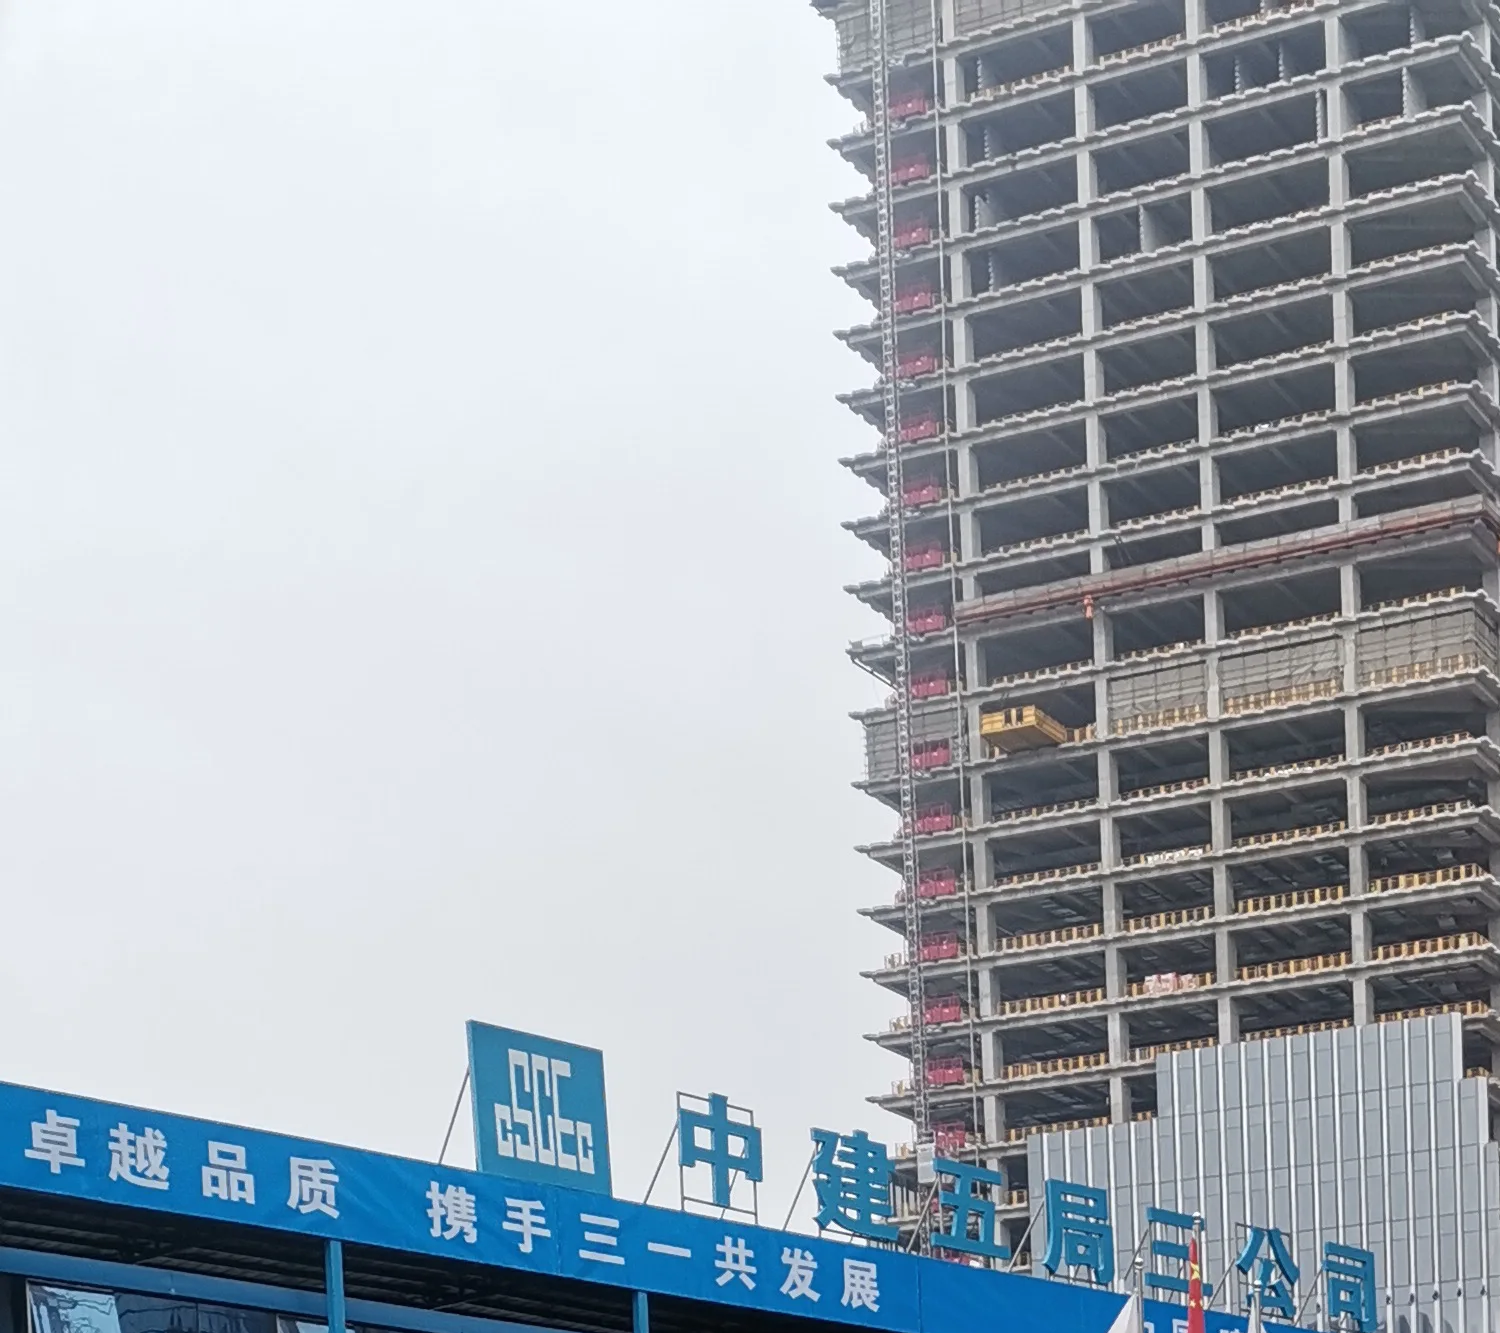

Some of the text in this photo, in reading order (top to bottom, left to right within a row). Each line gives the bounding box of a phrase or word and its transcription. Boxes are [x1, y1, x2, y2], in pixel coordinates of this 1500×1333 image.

[24, 1109, 880, 1312] 卓越品质 携手三一共发展
[678, 1092, 1377, 1333] 中建五局三公司
